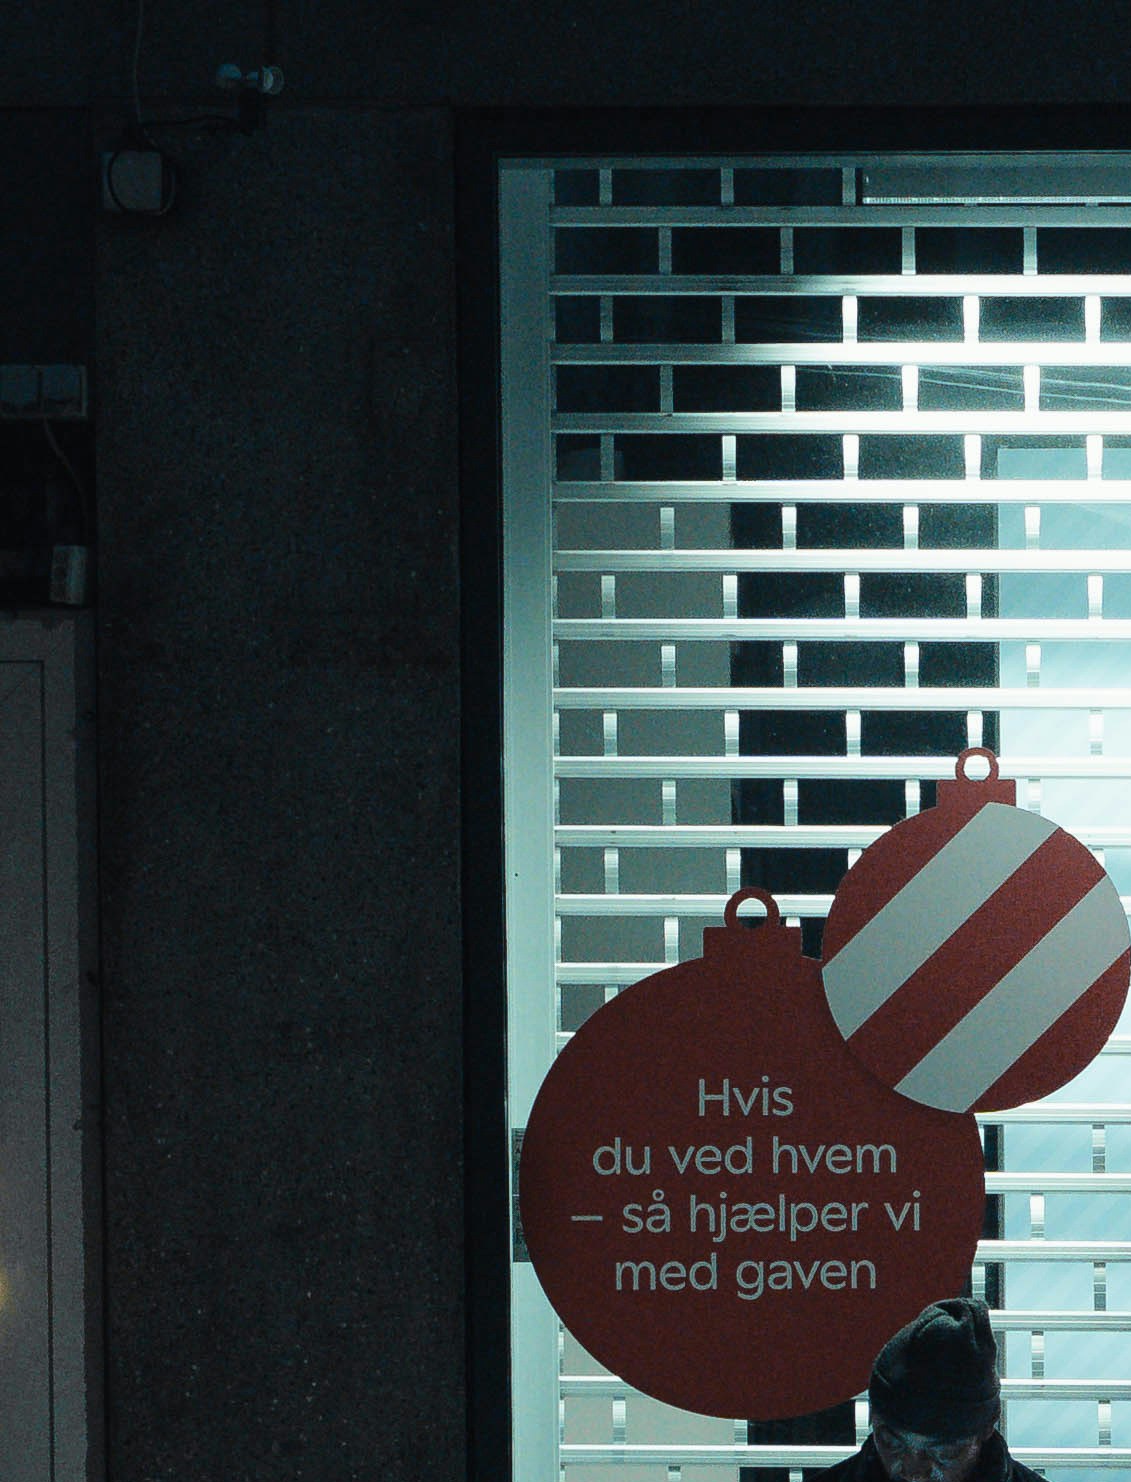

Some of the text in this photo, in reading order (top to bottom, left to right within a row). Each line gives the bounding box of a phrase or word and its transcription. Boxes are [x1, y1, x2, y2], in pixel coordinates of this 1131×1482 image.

[698, 1075, 794, 1117] Hvis
[592, 1135, 897, 1176] du ved hvem
[622, 1188, 671, 1234] så
[690, 1191, 869, 1243] hjælper
[883, 1189, 921, 1231] vi
[615, 1252, 877, 1301] med gaven
